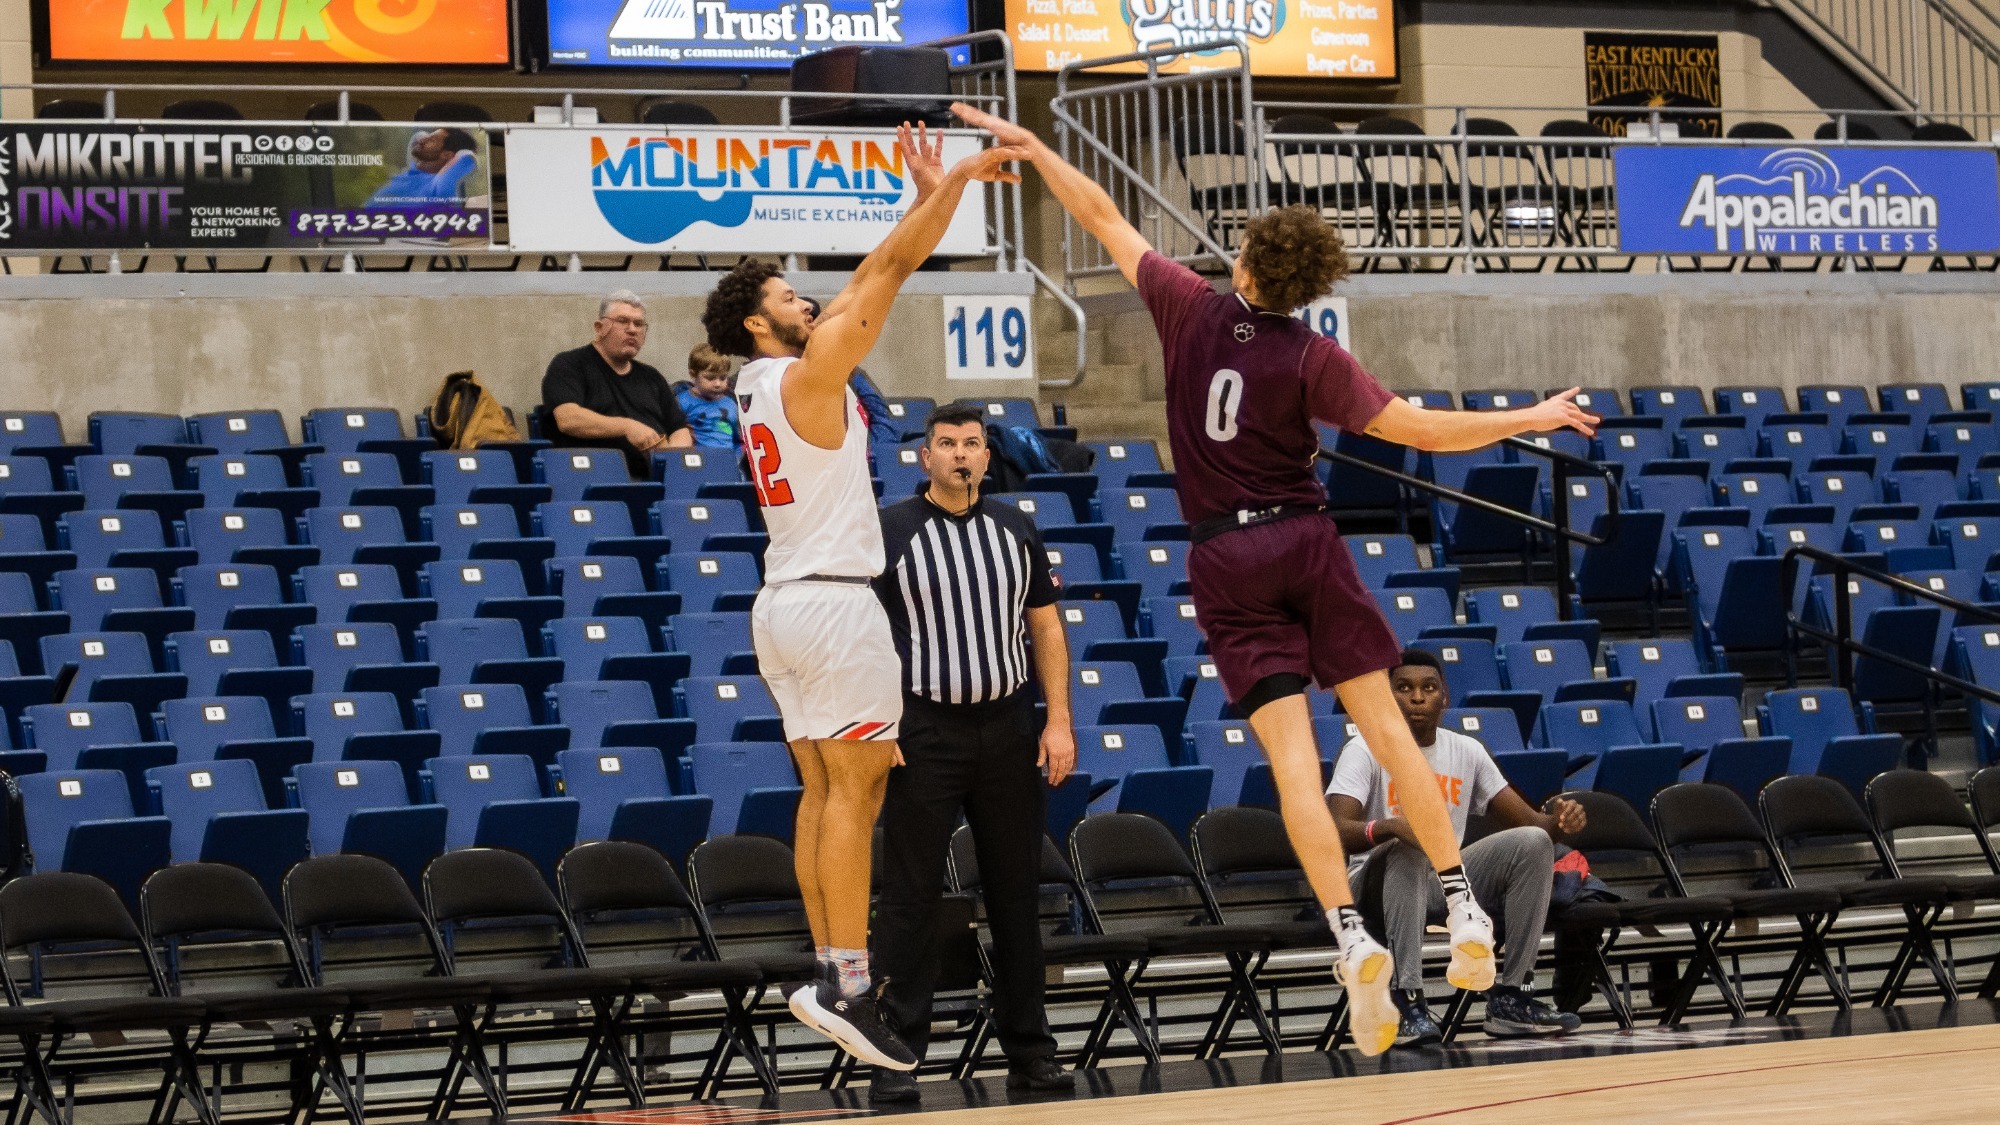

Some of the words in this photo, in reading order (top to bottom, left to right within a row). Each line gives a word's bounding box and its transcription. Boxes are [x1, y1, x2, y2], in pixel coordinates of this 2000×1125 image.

[697, 2, 797, 41] Trust
[804, 0, 902, 42] Bank
[1338, 1, 1378, 20] Parties
[1017, 22, 1051, 42] Salad
[1053, 23, 1062, 42] &
[1065, 23, 1110, 42] Dessert
[1311, 26, 1370, 47] Gameroom
[610, 44, 680, 60] building
[1586, 44, 1627, 64] EAST
[1631, 46, 1718, 67] KENTUCKY
[1306, 52, 1347, 76] Bumper
[1349, 53, 1376, 73] Cars
[1587, 63, 1720, 107] EXTERMINATING
[16, 132, 253, 184] MIKROTEC
[234, 153, 285, 165] RESIDENTIAL
[295, 154, 336, 166] BUSINESS
[337, 154, 383, 166] SOLUTIONS
[590, 137, 903, 189] MOUNTAIN
[17, 186, 184, 232] ONSITE
[190, 206, 222, 216] YOUR
[225, 206, 260, 216] HOME
[262, 206, 278, 216] PC
[753, 207, 807, 222] MUSIC
[811, 208, 904, 223] EXCHANGE
[1679, 170, 1938, 250] Appalachian
[190, 217, 199, 227] &
[202, 217, 281, 227] NETWORKING
[191, 227, 236, 238] EXPERTS
[296, 212, 483, 233] 877.323.4948
[1758, 233, 1939, 251] WIRELESS
[947, 305, 1028, 369] 119
[1205, 368, 1244, 442] 0
